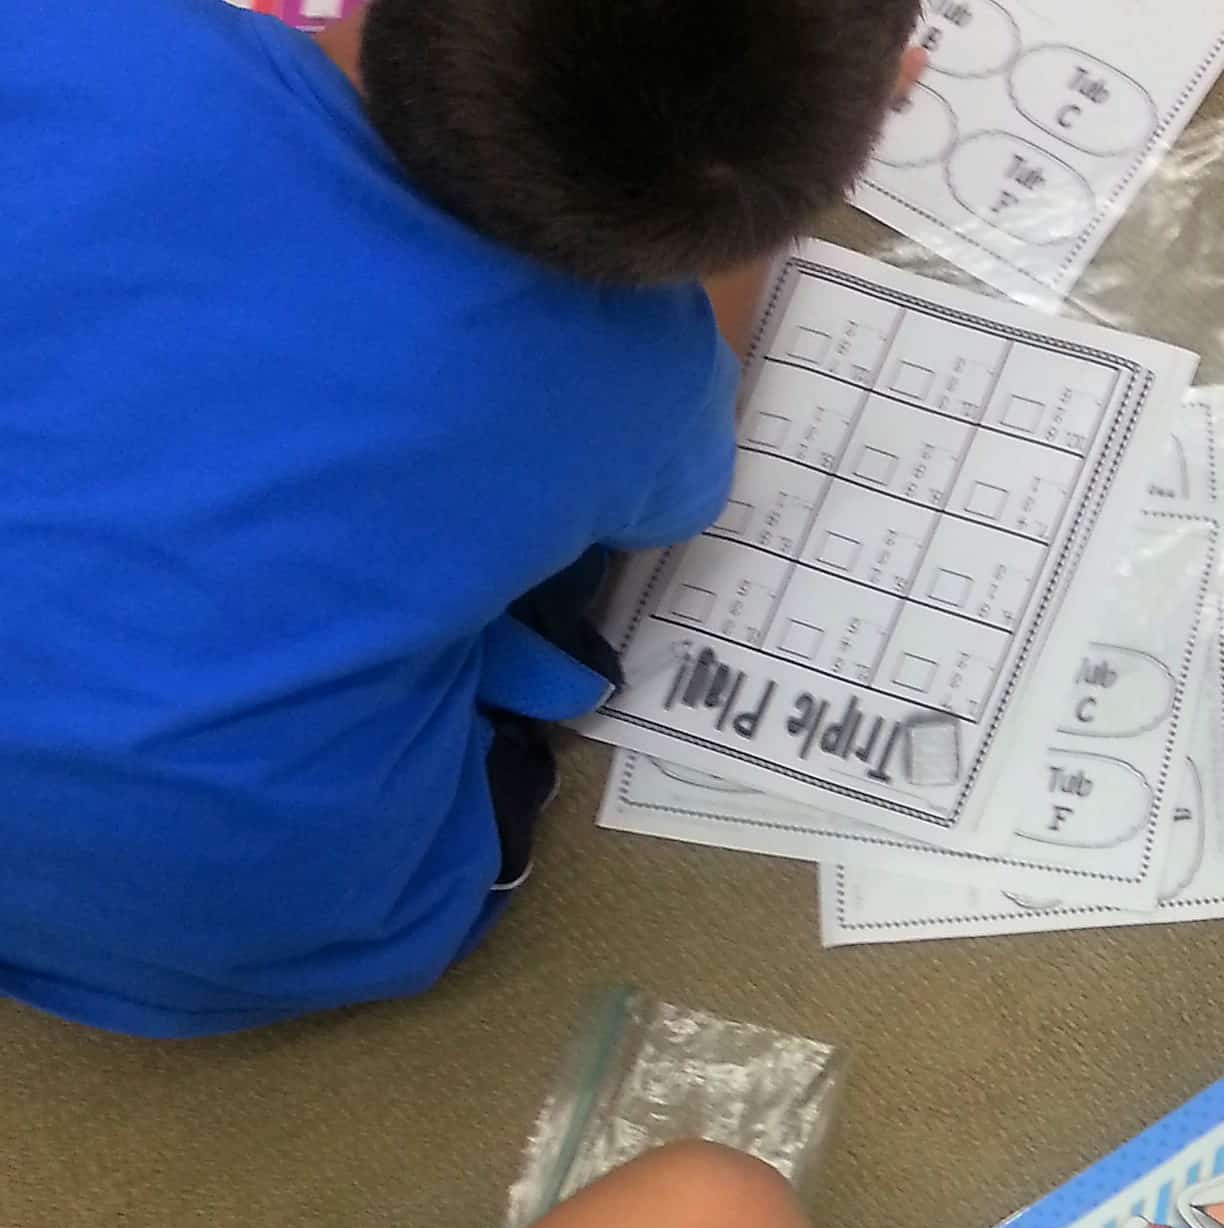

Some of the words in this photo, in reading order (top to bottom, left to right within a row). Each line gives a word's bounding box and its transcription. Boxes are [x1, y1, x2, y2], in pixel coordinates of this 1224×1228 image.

[1055, 104, 1081, 128] C
[1074, 696, 1097, 723] C
[786, 692, 891, 784] Triple
